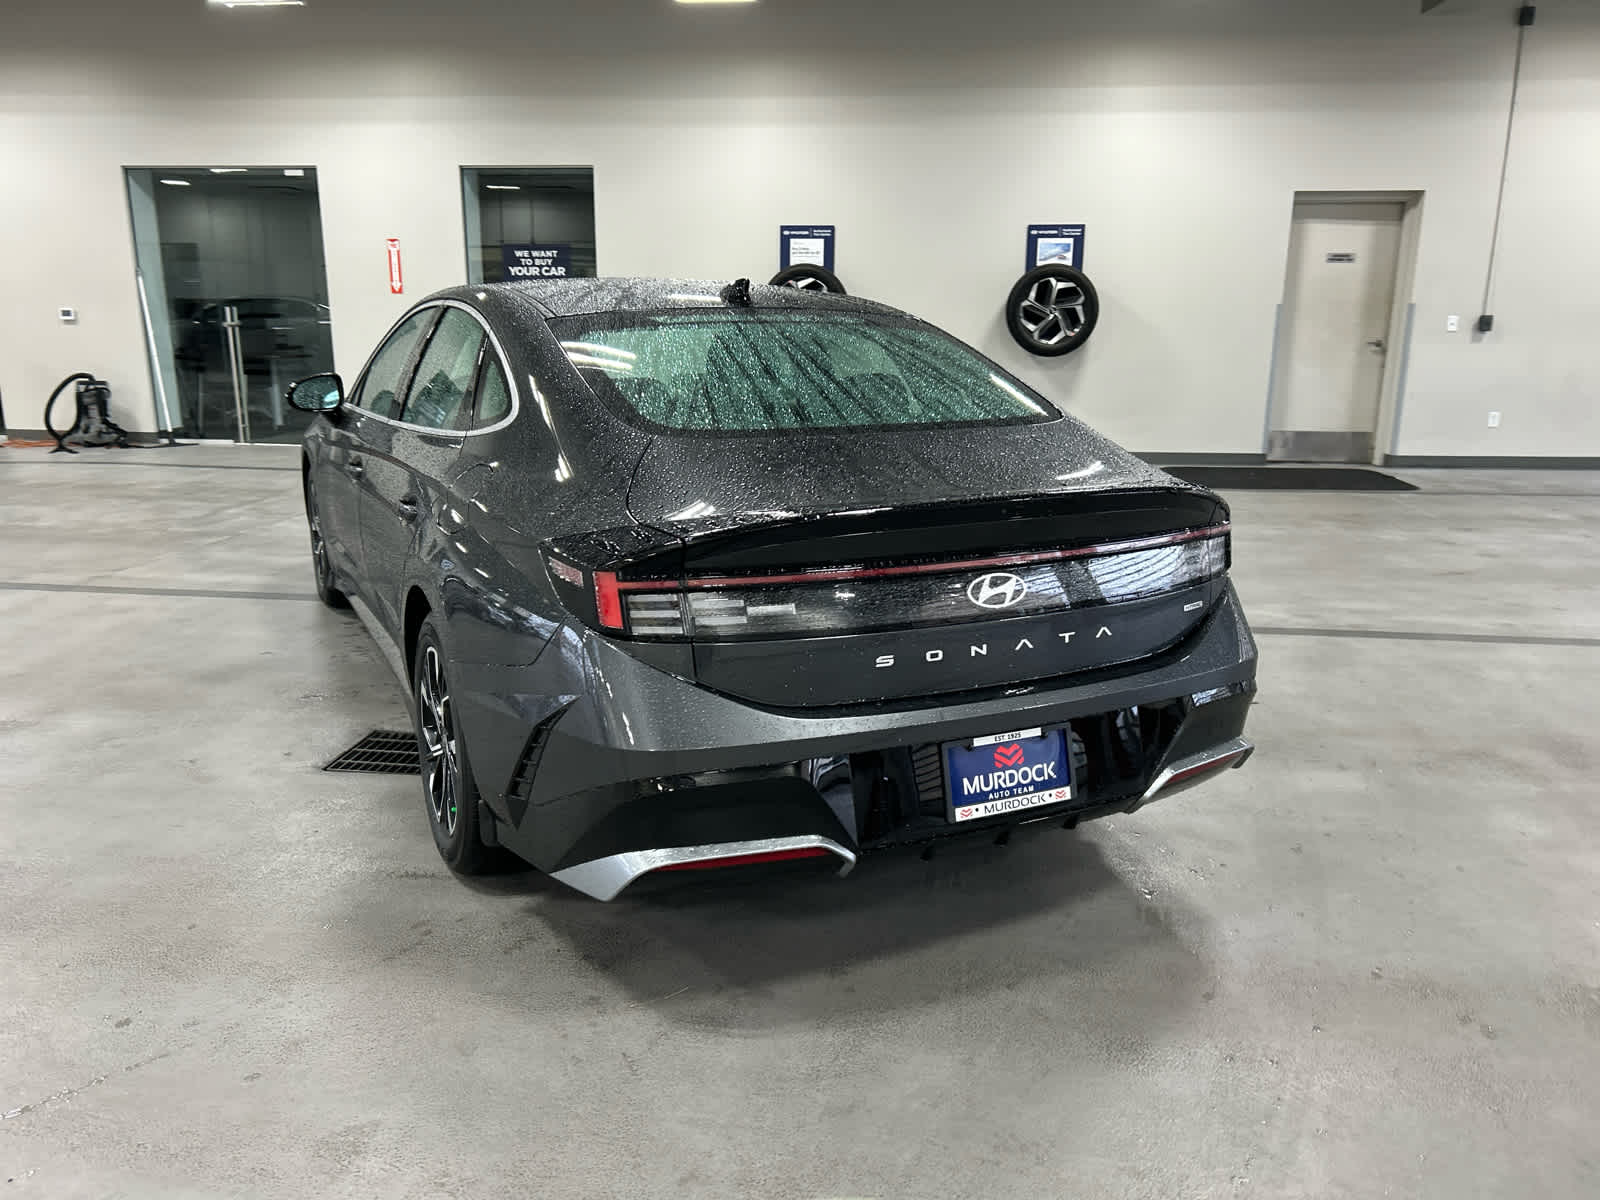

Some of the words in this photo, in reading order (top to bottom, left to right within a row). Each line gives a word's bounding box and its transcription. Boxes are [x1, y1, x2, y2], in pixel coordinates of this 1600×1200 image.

[520, 258, 533, 266] TO
[534, 258, 553, 266] BUY
[508, 266, 540, 276] YOUR
[541, 266, 566, 276] CAR
[874, 626, 1113, 668] SONATA
[1007, 732, 1022, 740] 1925
[962, 761, 1057, 796] MURDOCK
[988, 789, 1010, 800] AUTO
[1013, 785, 1035, 796] TEAM
[984, 793, 1047, 814] MURDOCK
